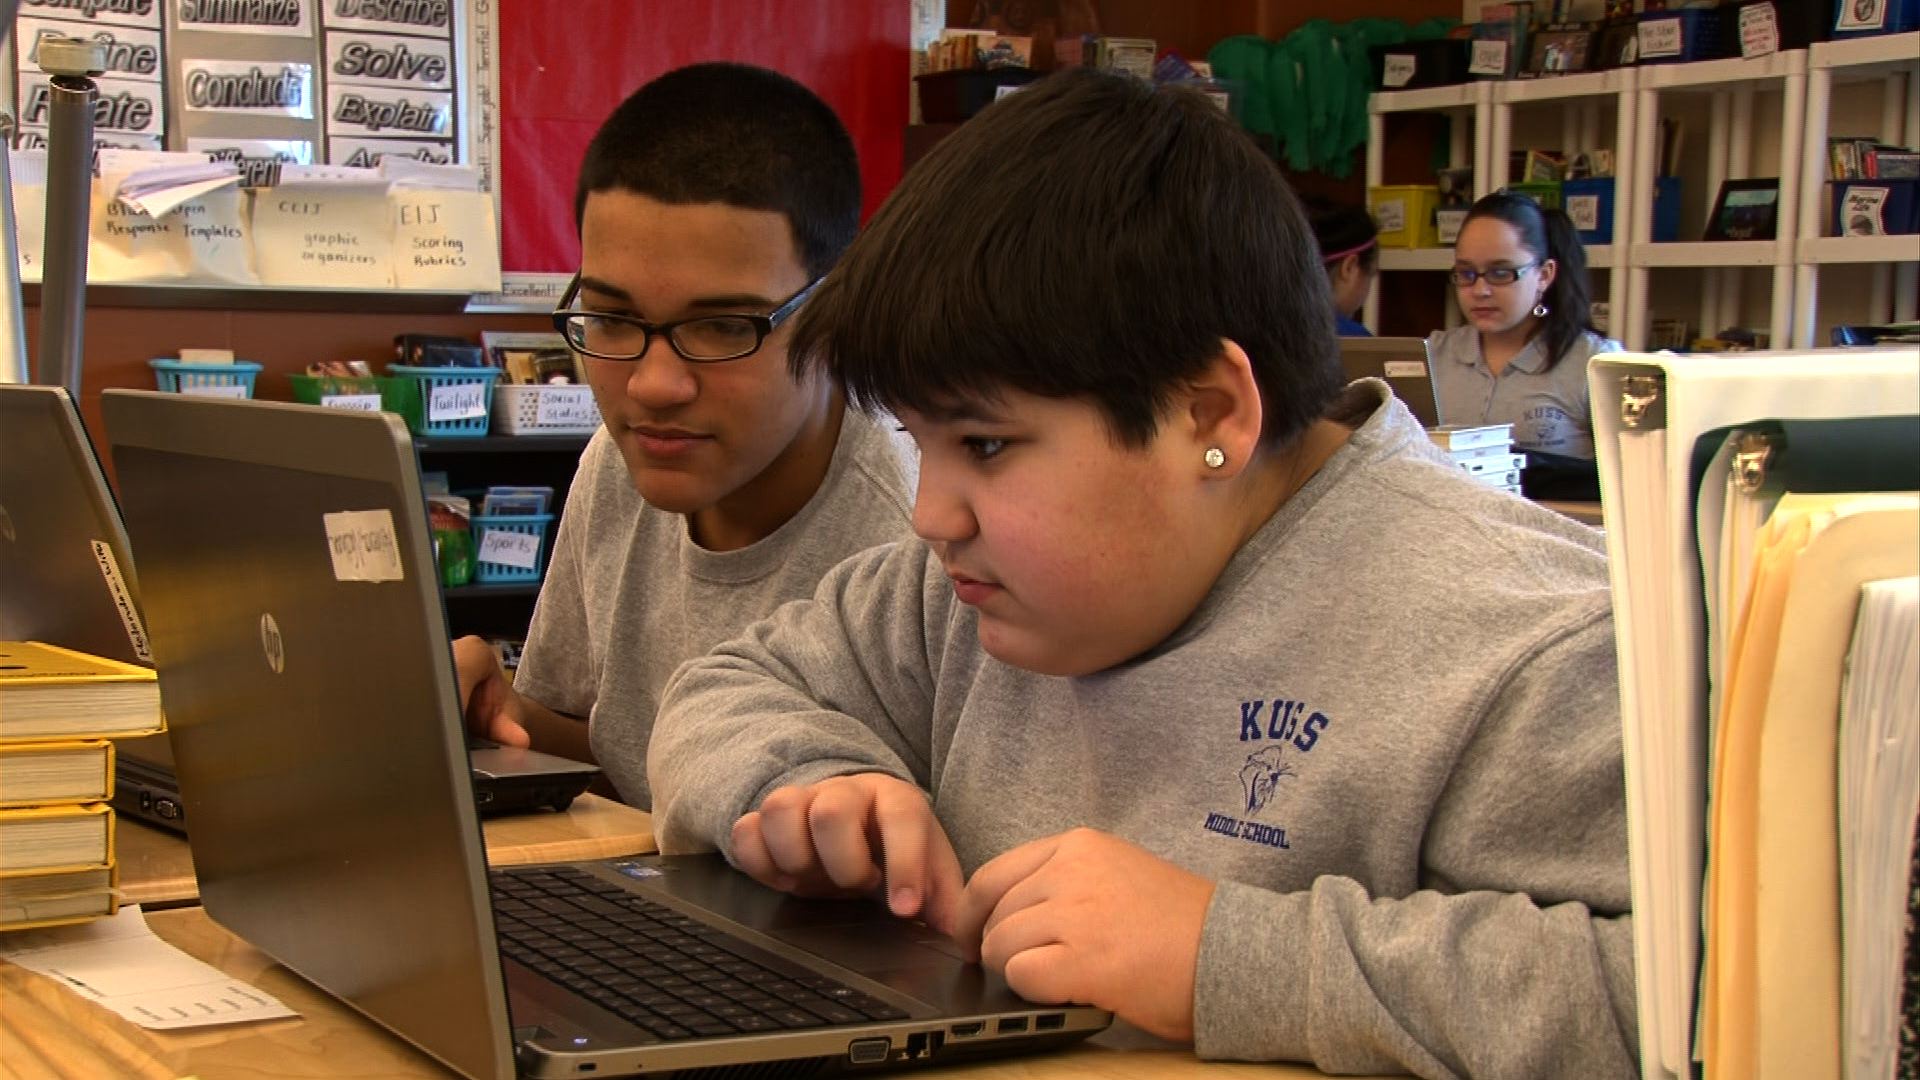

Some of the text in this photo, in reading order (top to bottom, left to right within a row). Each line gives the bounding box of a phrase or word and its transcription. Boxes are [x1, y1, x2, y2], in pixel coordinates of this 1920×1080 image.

[334, 41, 446, 82] Solve
[186, 67, 302, 108] Conclude
[23, 85, 152, 130] Rate
[334, 93, 447, 133] Explain
[400, 204, 441, 225] EIJ
[106, 221, 243, 241] Response Templates
[304, 231, 359, 248] graphic
[412, 235, 464, 254] Scoring
[301, 251, 377, 266] organizers
[413, 254, 467, 267] Rubrics
[433, 394, 481, 416] Twilight
[541, 392, 582, 405] Social
[544, 407, 589, 420] Studies
[1523, 406, 1564, 422] KUSS
[485, 533, 532, 554] Sports
[1239, 698, 1329, 752] KUSS
[1203, 811, 1291, 850] MIDDLE SCHOOL
